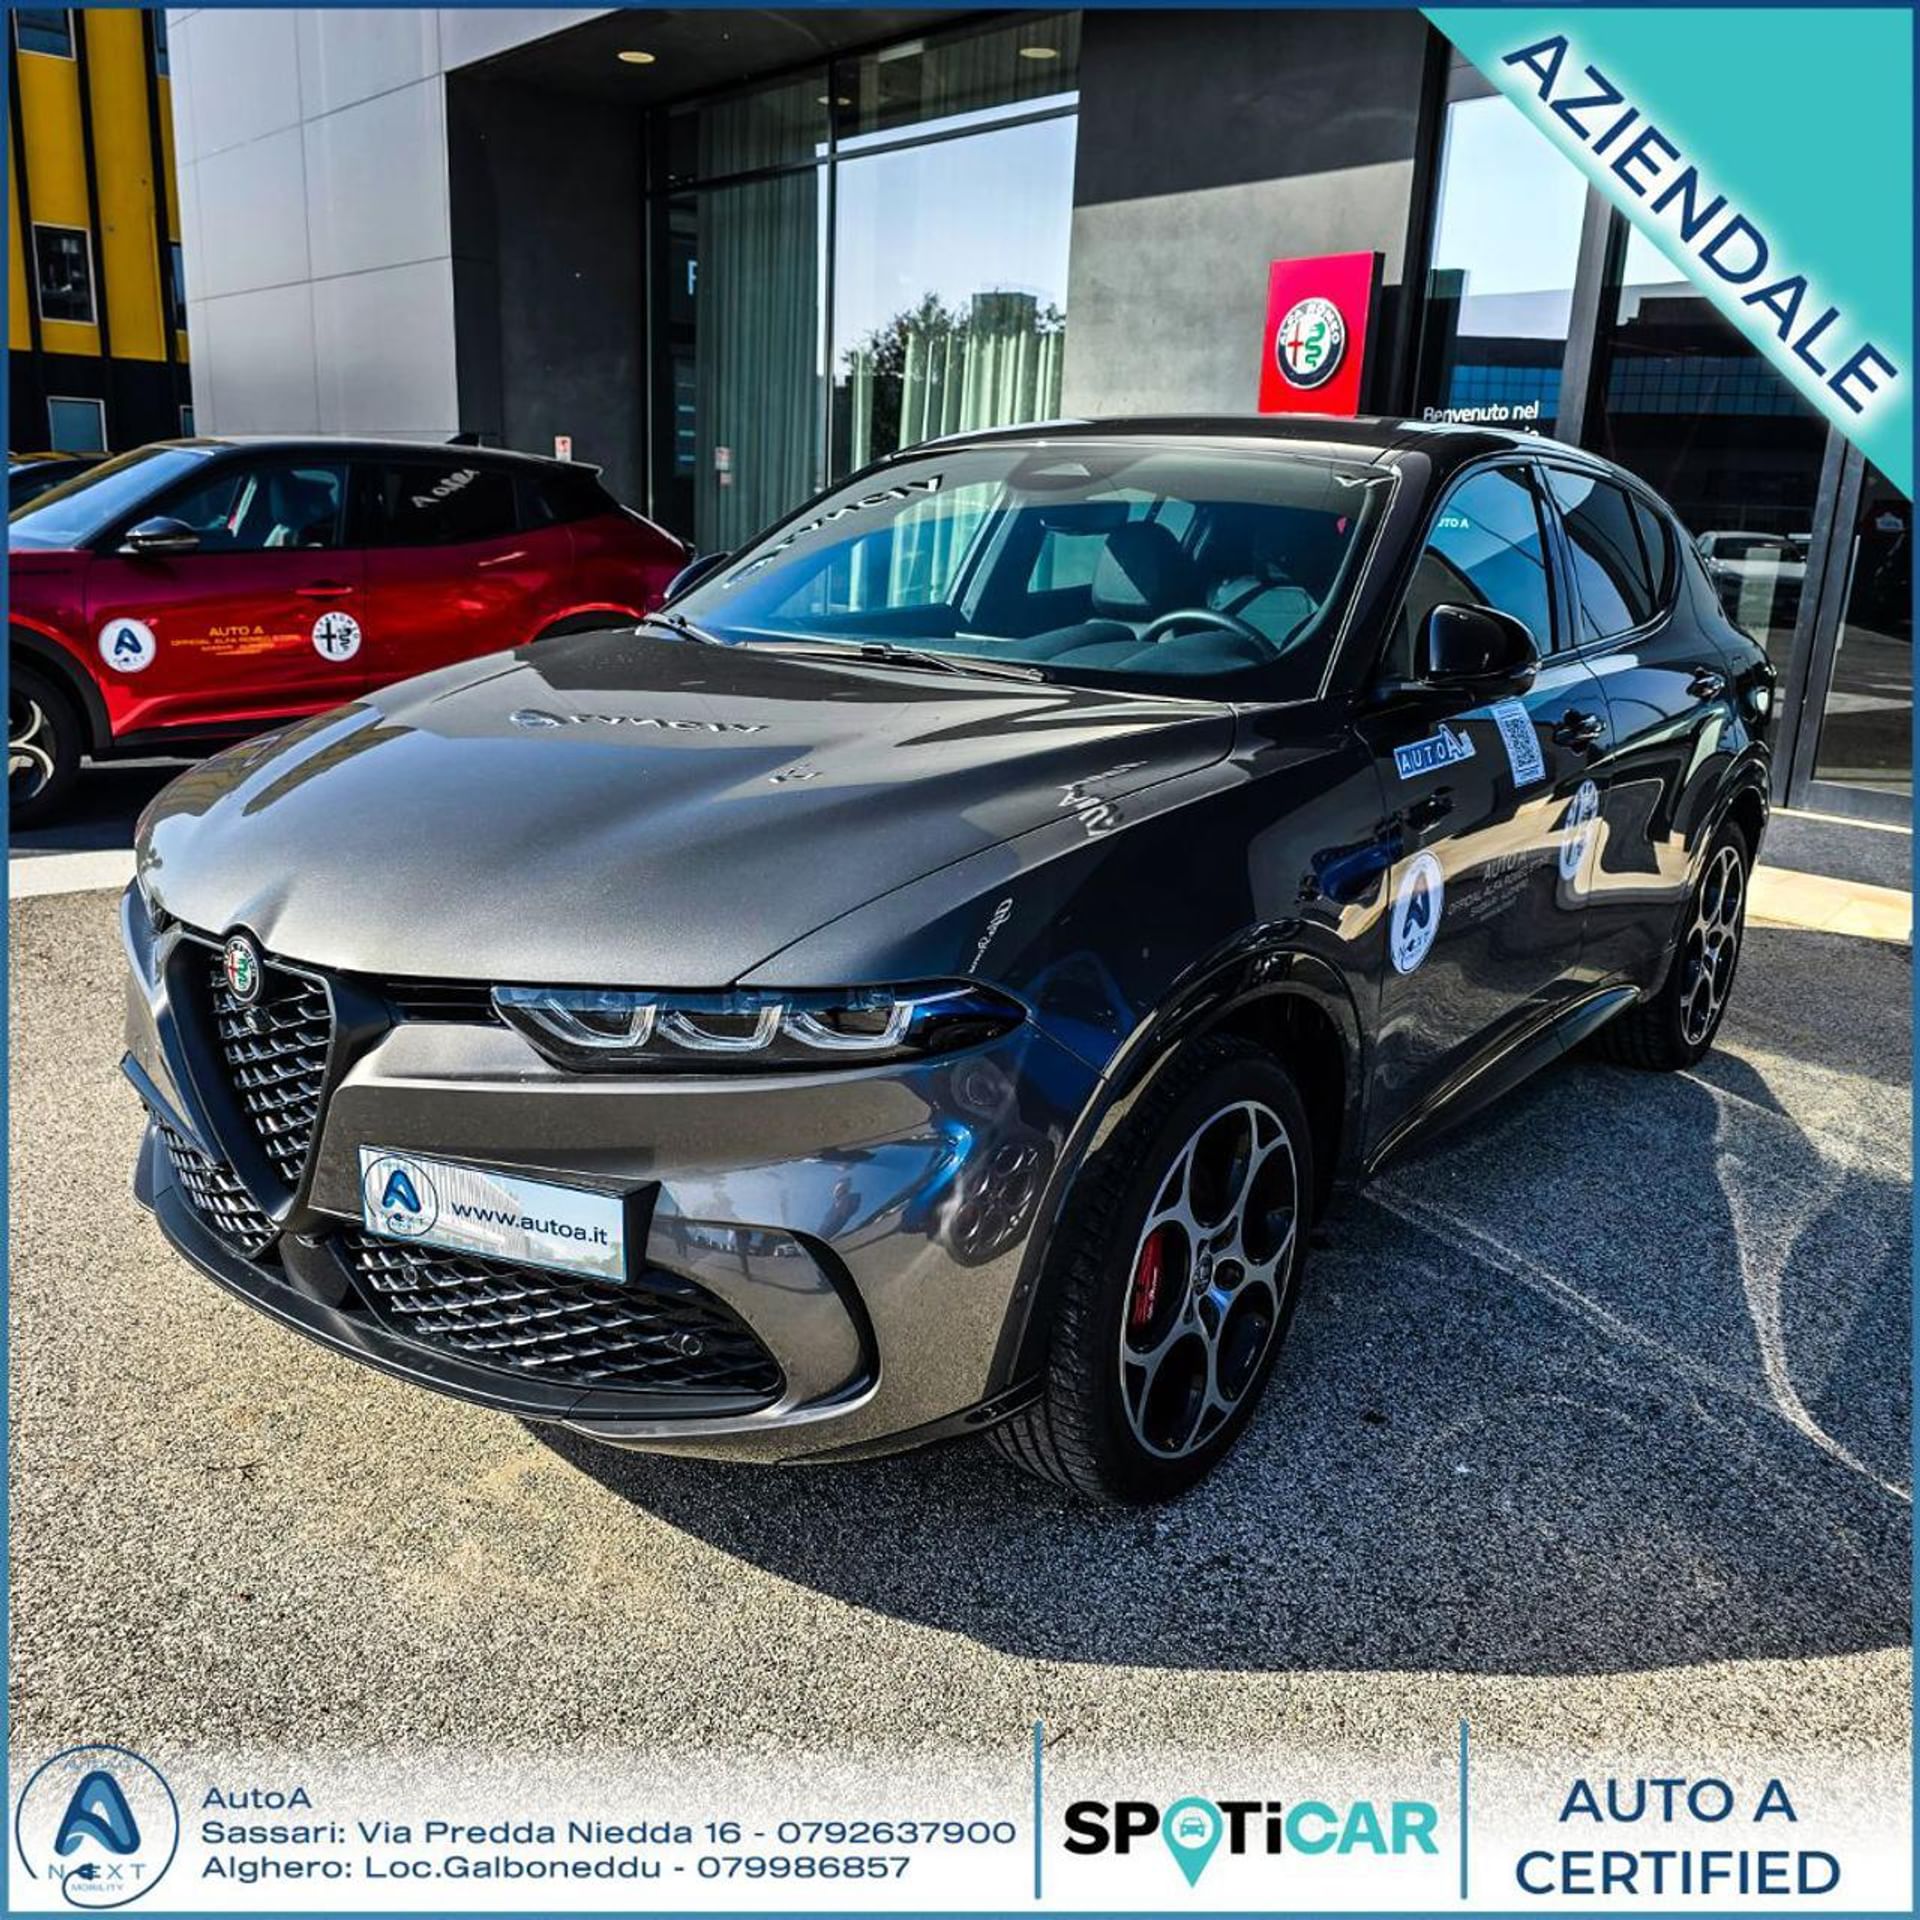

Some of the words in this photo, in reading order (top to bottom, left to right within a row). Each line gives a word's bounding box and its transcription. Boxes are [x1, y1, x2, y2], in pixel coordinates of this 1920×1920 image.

[1423, 403, 1509, 423] Benvenuto
[1512, 399, 1539, 420] nel
[208, 625, 251, 637] AUTO
[252, 625, 265, 635] A
[450, 1200, 609, 1246] www.autoa.it
